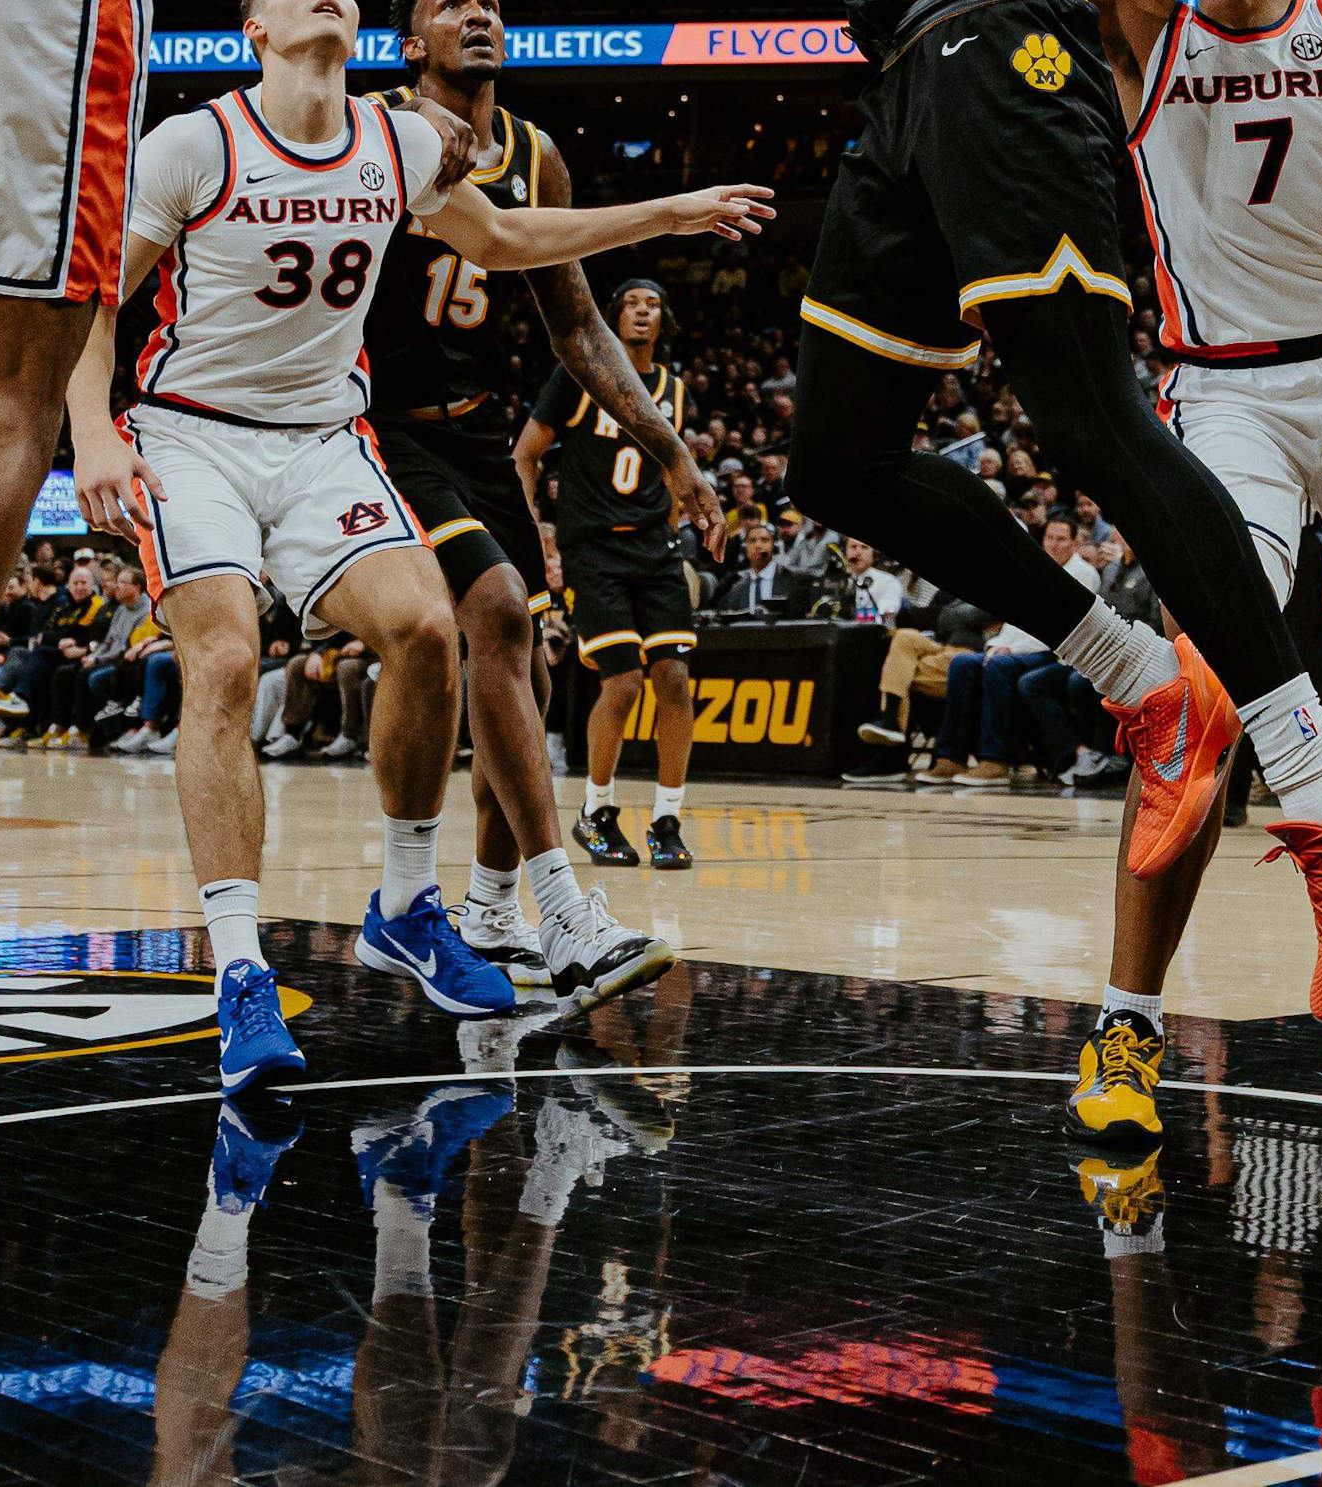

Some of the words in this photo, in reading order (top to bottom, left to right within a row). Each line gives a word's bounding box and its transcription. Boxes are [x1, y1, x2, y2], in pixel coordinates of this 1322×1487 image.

[504, 30, 643, 59] HLETICS
[1034, 69, 1058, 87] M
[1234, 116, 1294, 206] 7
[225, 196, 396, 224] AUBURN
[254, 239, 373, 310] 38
[424, 254, 489, 329] 15
[612, 446, 643, 495] 0
[623, 677, 815, 745] IZOU
